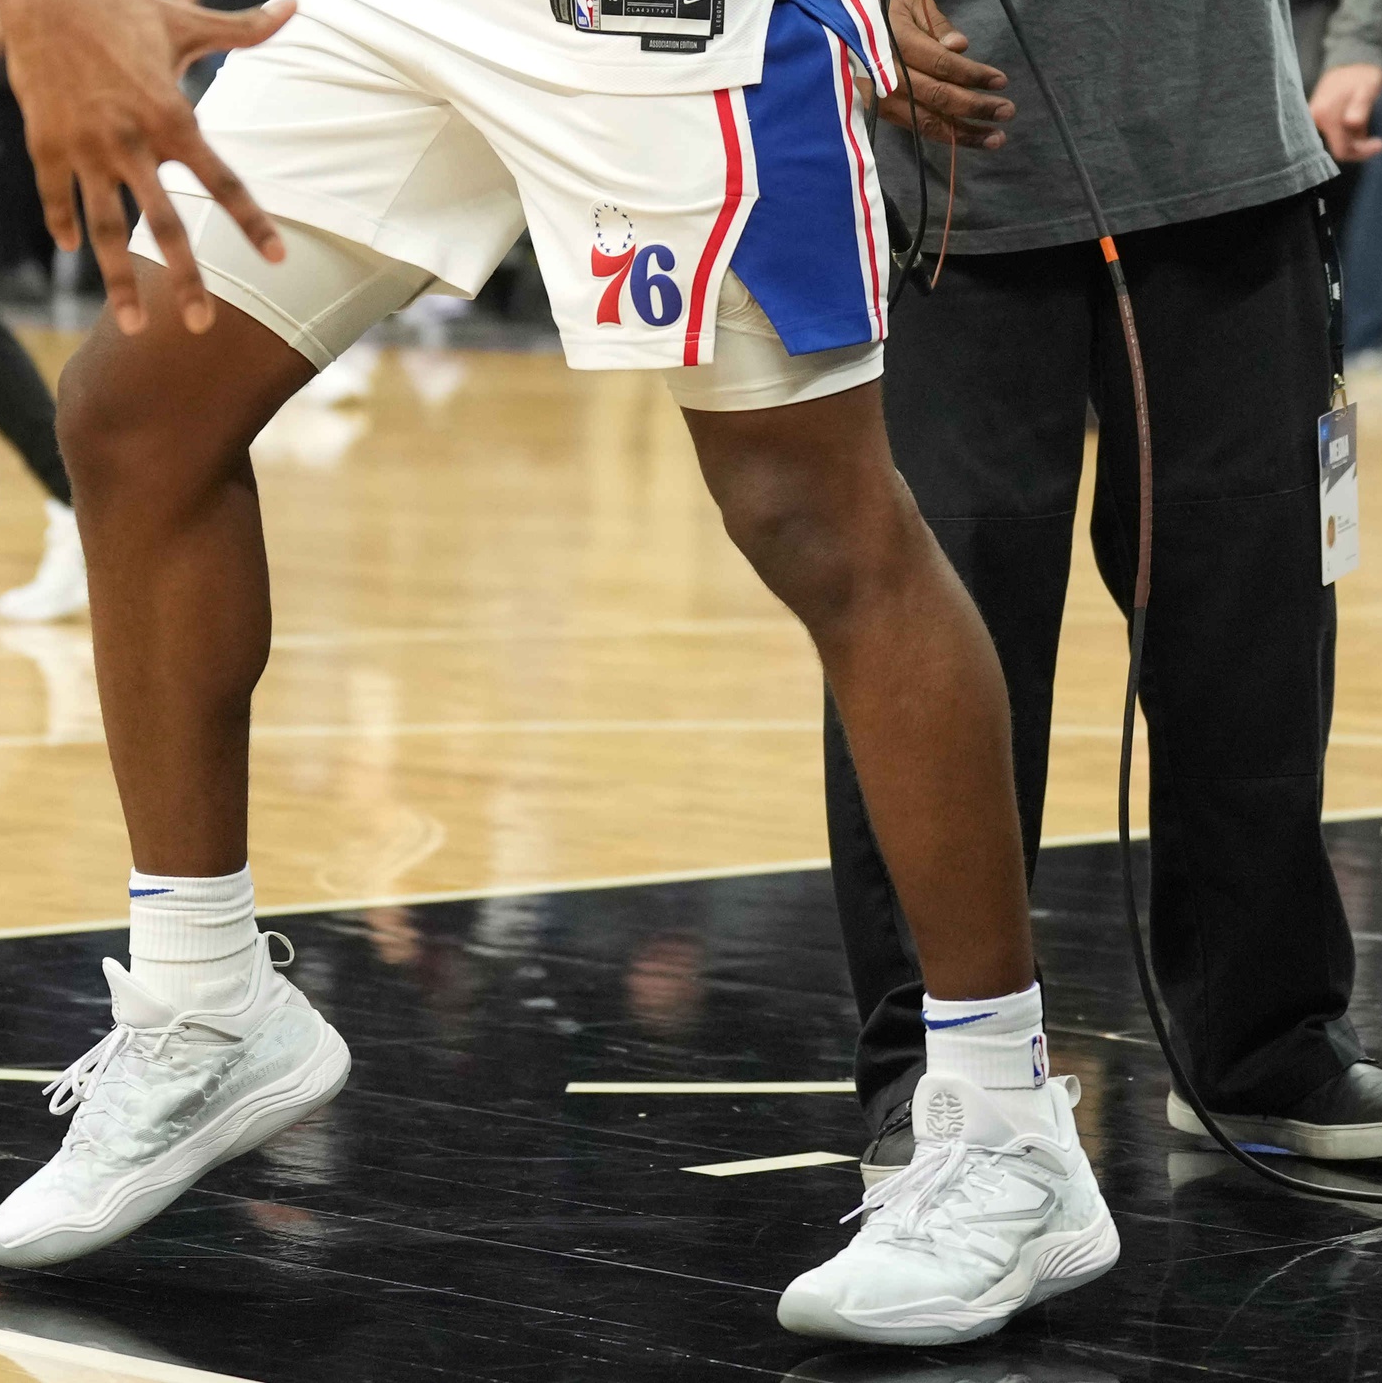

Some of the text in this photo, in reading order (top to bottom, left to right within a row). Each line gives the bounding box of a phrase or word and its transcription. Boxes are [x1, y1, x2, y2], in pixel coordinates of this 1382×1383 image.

[649, 39, 698, 50] ASSOCIATION EDITION
[590, 243, 683, 327] 76
